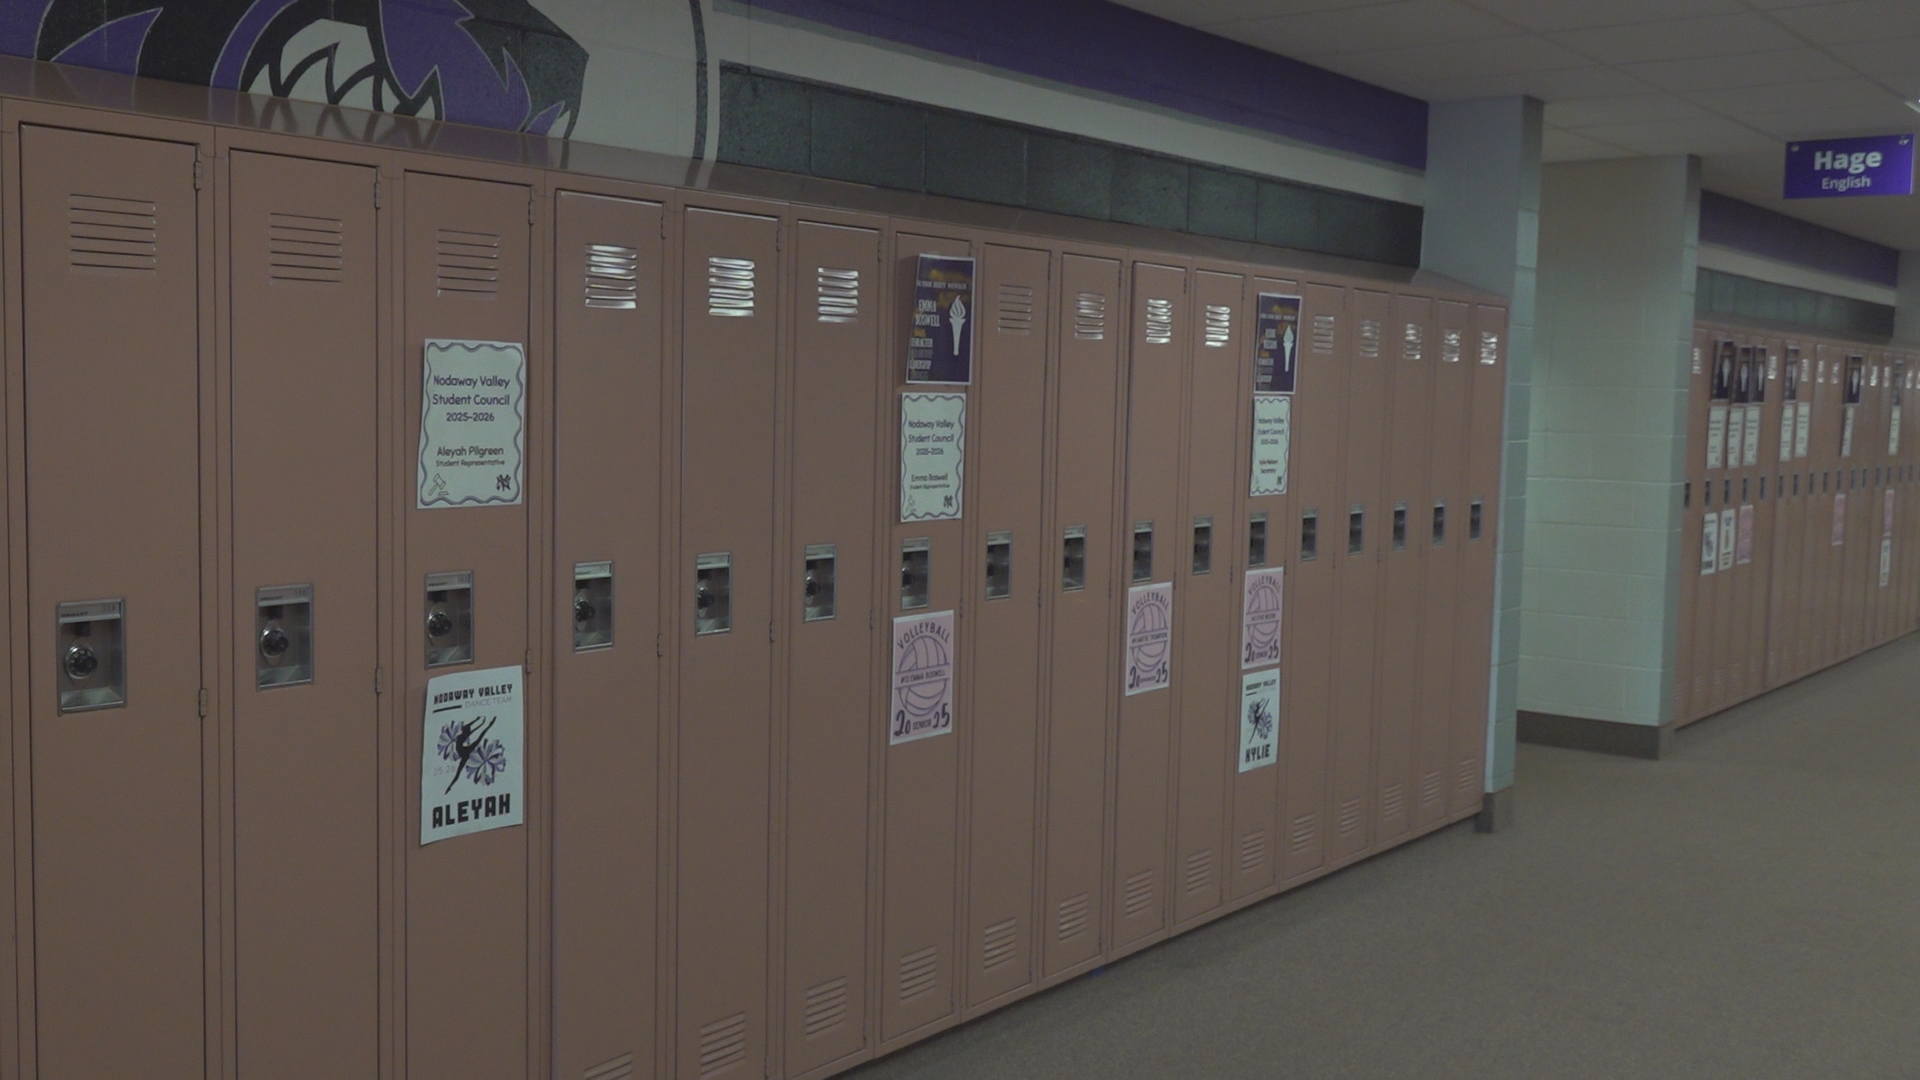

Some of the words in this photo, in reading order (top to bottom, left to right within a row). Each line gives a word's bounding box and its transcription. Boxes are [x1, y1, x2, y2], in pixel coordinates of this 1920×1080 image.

[1814, 150, 1882, 174] Hage
[1822, 175, 1871, 192] English
[433, 374, 478, 389] Nodaway
[479, 375, 510, 390] Valley
[432, 393, 472, 405] Student
[473, 394, 510, 406] Council
[908, 420, 935, 430] Nodaway
[931, 434, 954, 443] Council
[437, 446, 467, 459] Aleyah
[468, 445, 504, 458] Pilgreen
[897, 622, 951, 649] VOLLEYBALL
[433, 688, 475, 705] NODAWAY
[478, 683, 513, 697] VALLEY
[465, 698, 492, 708] DANCE
[494, 696, 512, 704] TEAM
[894, 709, 911, 736] 20
[933, 702, 950, 728] 25
[1245, 744, 1271, 763] KYLIE
[432, 793, 511, 829] ALEYAH
